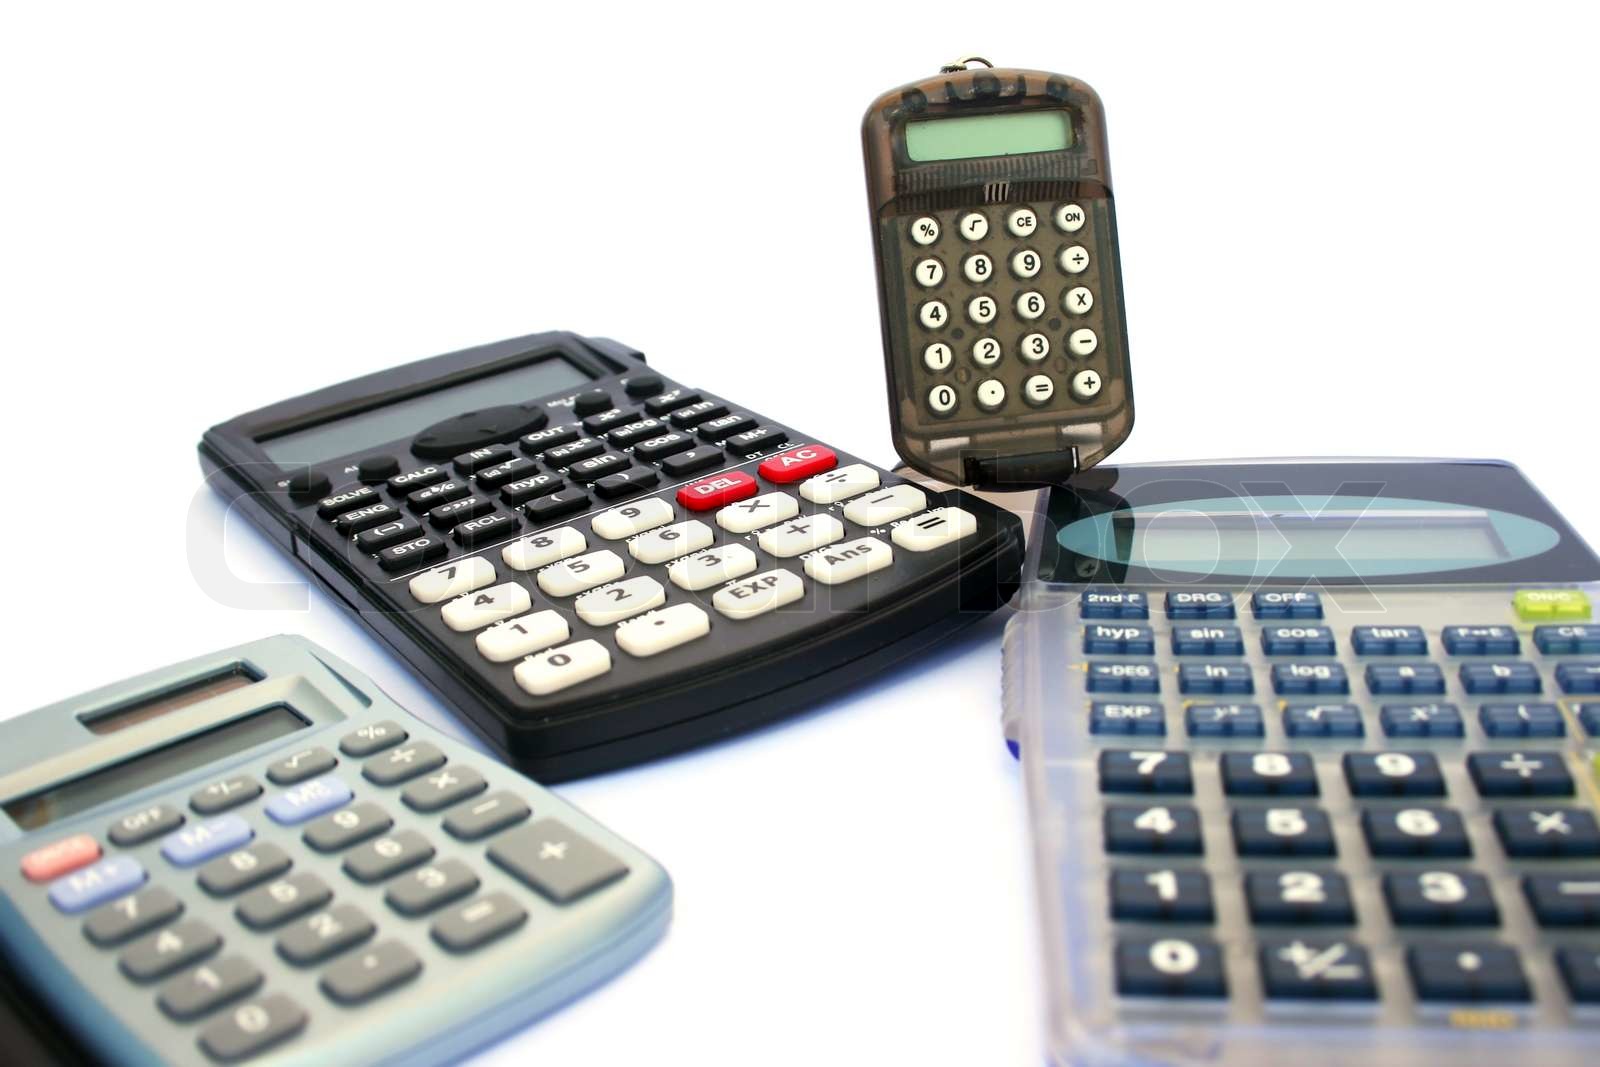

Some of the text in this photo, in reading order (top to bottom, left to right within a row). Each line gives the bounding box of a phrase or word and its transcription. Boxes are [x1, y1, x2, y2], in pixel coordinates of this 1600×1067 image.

[921, 224, 934, 237] %
[1016, 217, 1032, 227] CE
[1065, 213, 1080, 222] ON
[927, 265, 937, 280] 7
[975, 259, 987, 275] 8
[1024, 255, 1035, 270] 9
[930, 306, 941, 321] 4
[979, 301, 991, 317] 5
[1028, 296, 1039, 313] 6
[935, 348, 943, 364] 1
[984, 343, 995, 358] 2
[1033, 338, 1044, 354] 3
[939, 389, 951, 405] 0
[528, 426, 564, 440] OUT
[395, 466, 437, 483] CALC
[583, 455, 616, 468] sin
[644, 434, 681, 447] cos
[709, 414, 742, 427] tan
[470, 448, 492, 459] IN
[322, 487, 373, 506] SOLVE
[509, 475, 549, 490] hyp
[739, 427, 767, 440] M+
[345, 504, 390, 520] ENG
[438, 450, 817, 580] 7 8 9 DEL AC
[463, 512, 506, 532] RCL
[392, 538, 431, 555] STO
[474, 594, 495, 607] 4
[567, 560, 590, 573] 5
[659, 530, 680, 540] 6
[509, 623, 528, 634] 1
[606, 588, 632, 601] 2
[697, 554, 722, 567] 3
[547, 654, 571, 666] 0
[728, 576, 778, 599] EXP
[824, 544, 872, 565] Ans
[1088, 593, 1122, 603] 2nd
[1128, 594, 1141, 603] F
[1177, 593, 1222, 603] DRG
[1265, 593, 1307, 603] OFF
[1097, 626, 1140, 639] hyp
[1190, 627, 1224, 639] sin
[1277, 628, 1319, 638] cos
[1371, 627, 1409, 638] tan
[1205, 664, 1228, 677] ln
[1291, 664, 1331, 679] log
[1104, 704, 1151, 718] EXP
[1129, 751, 1166, 775] 7
[1253, 753, 1292, 777] 8
[1375, 753, 1416, 777] 9
[1135, 807, 1175, 835] 4
[1266, 808, 1307, 836] 5
[1396, 808, 1440, 836] 6
[1146, 870, 1467, 903] 1 2 3
[309, 913, 343, 938] 2
[1149, 940, 1199, 974] 0
